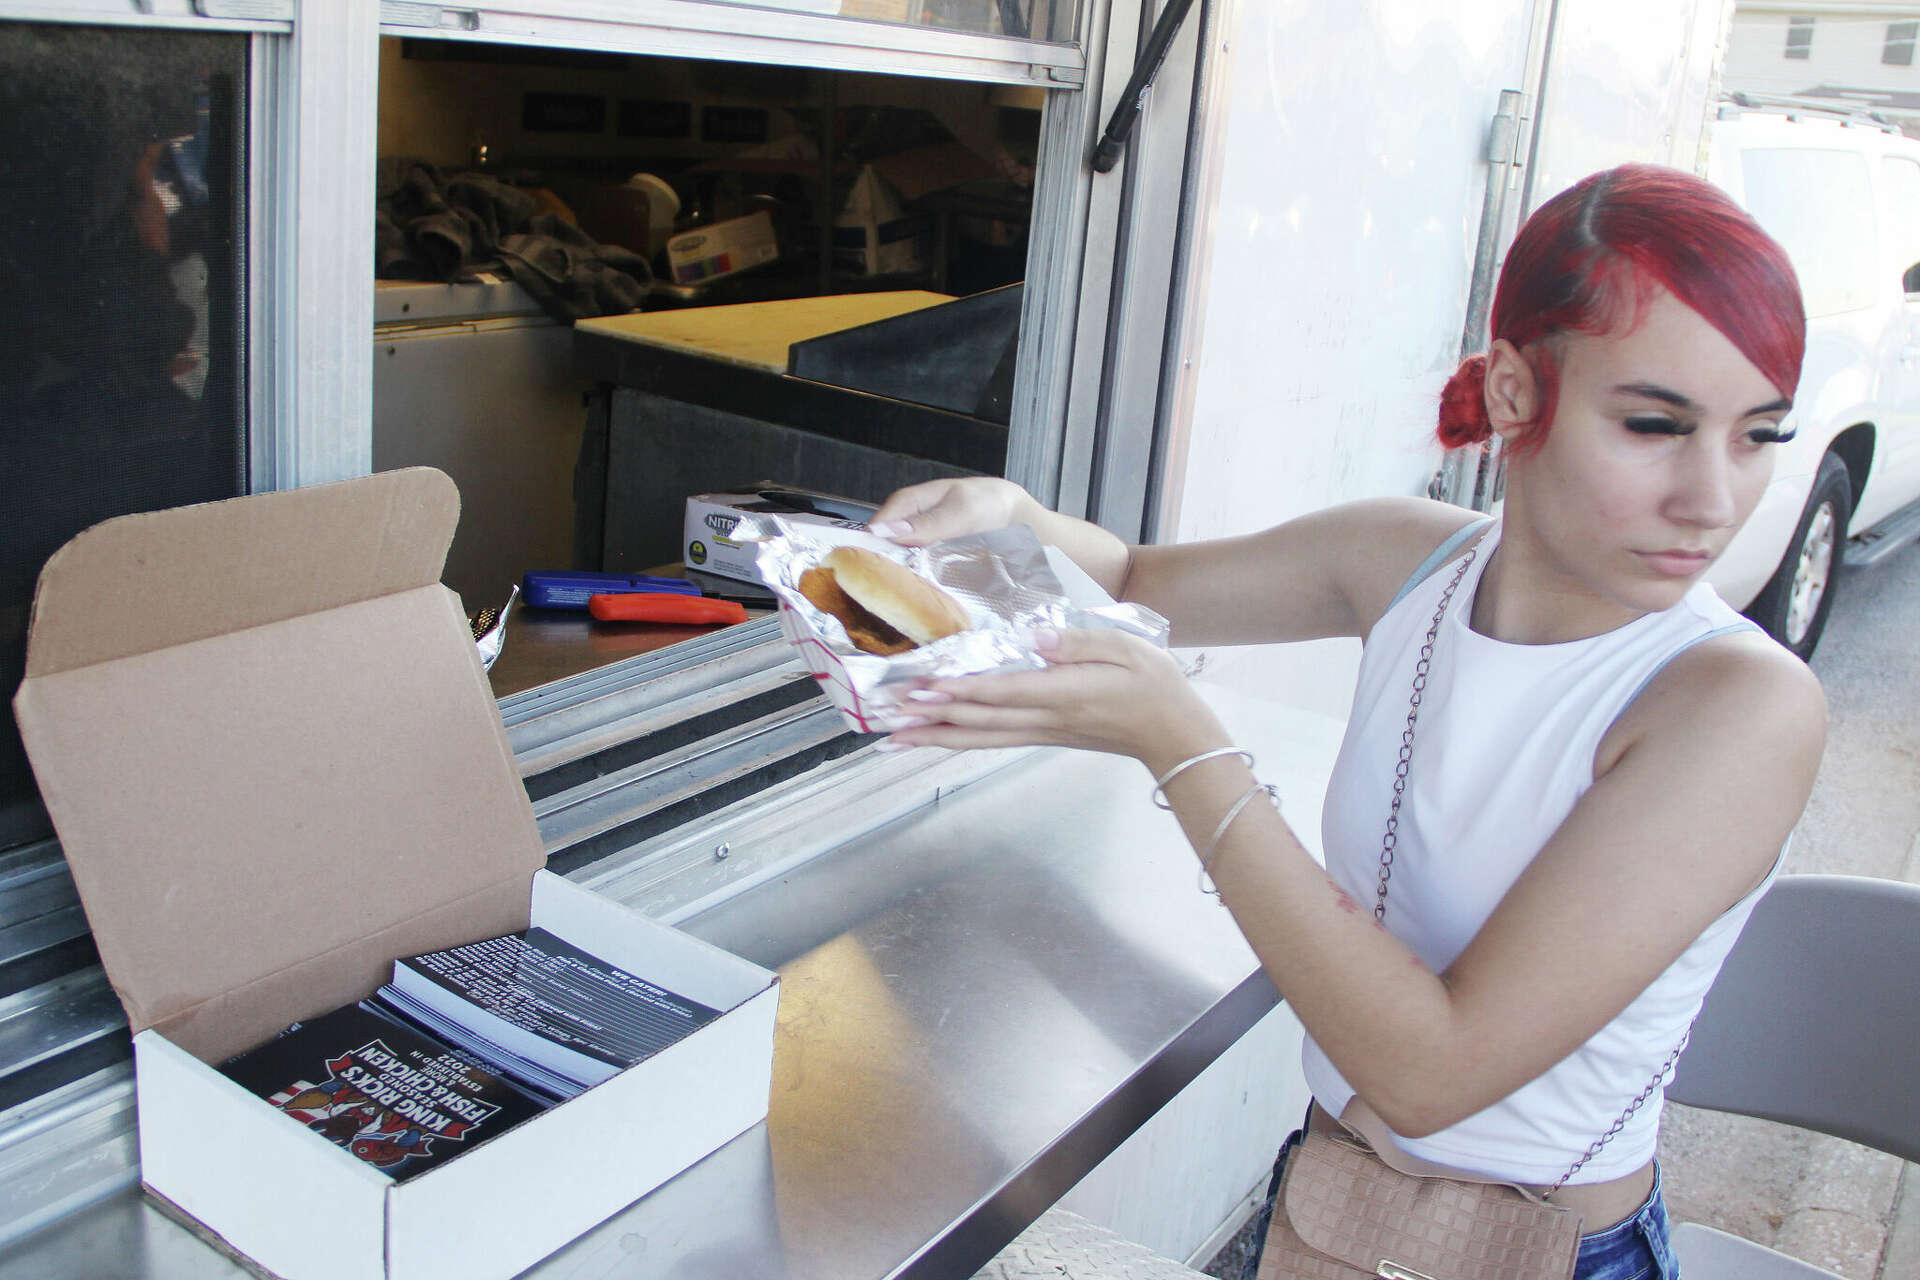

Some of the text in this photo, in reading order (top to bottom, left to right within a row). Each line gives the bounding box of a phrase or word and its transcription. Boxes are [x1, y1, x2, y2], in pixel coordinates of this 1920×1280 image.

[611, 971, 630, 979] WE
[409, 1050, 424, 1060] IN
[438, 1054, 471, 1074] 2022
[358, 1047, 435, 1091] CHICKEN
[420, 1065, 449, 1083] MORE
[422, 1058, 483, 1092] ESTABLISHED
[340, 1066, 452, 1132] KING RICK'S
[378, 1073, 437, 1108] SEASONED
[431, 1085, 448, 1097] &
[438, 1092, 487, 1121] FISH
